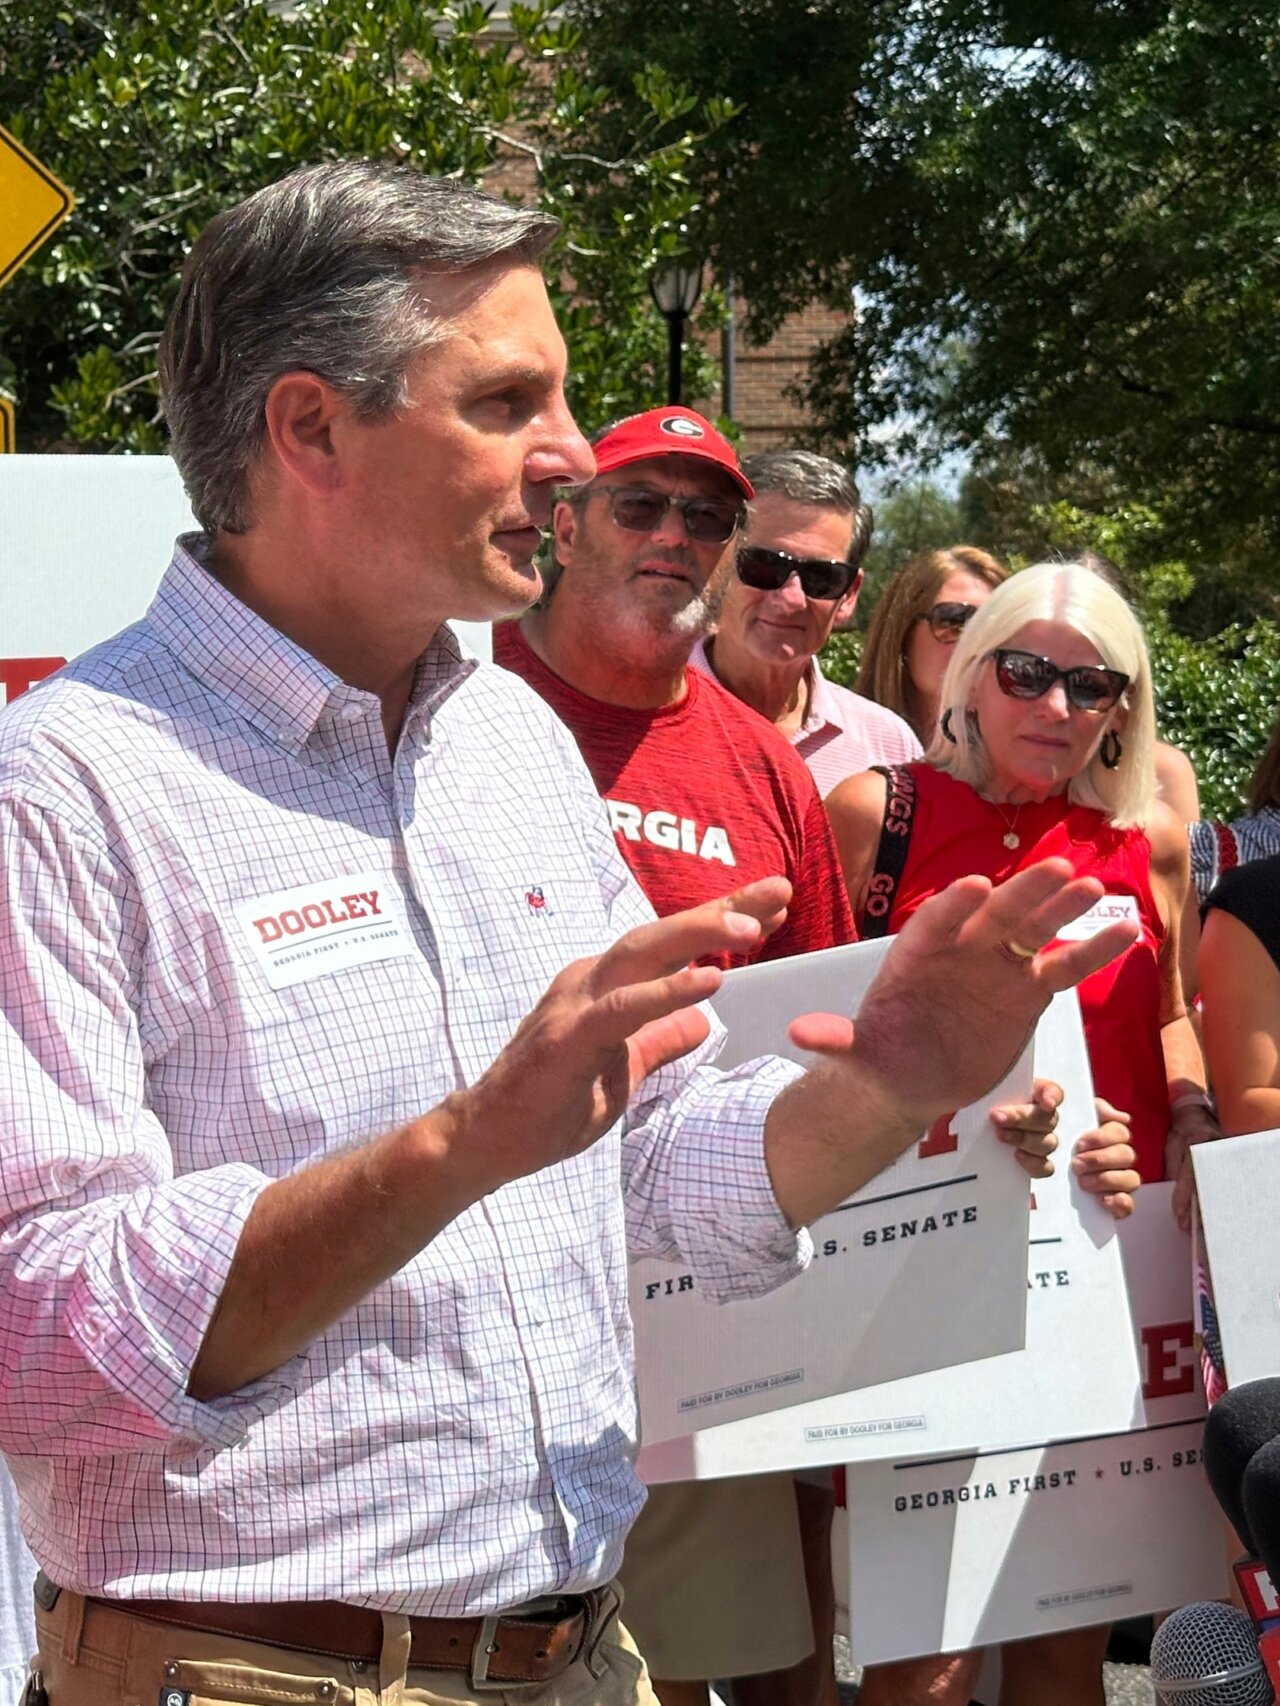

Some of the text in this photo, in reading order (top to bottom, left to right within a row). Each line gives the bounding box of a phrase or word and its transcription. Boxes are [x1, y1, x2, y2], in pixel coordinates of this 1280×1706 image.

[867, 873, 894, 916] GO
[252, 890, 382, 944] DOOLEY
[273, 951, 312, 967] GEORGIA
[314, 942, 339, 955] FIRST
[862, 1205, 978, 1247] SENATE
[894, 1450, 1204, 1512] GEORGIA FIRST U.S. SE
